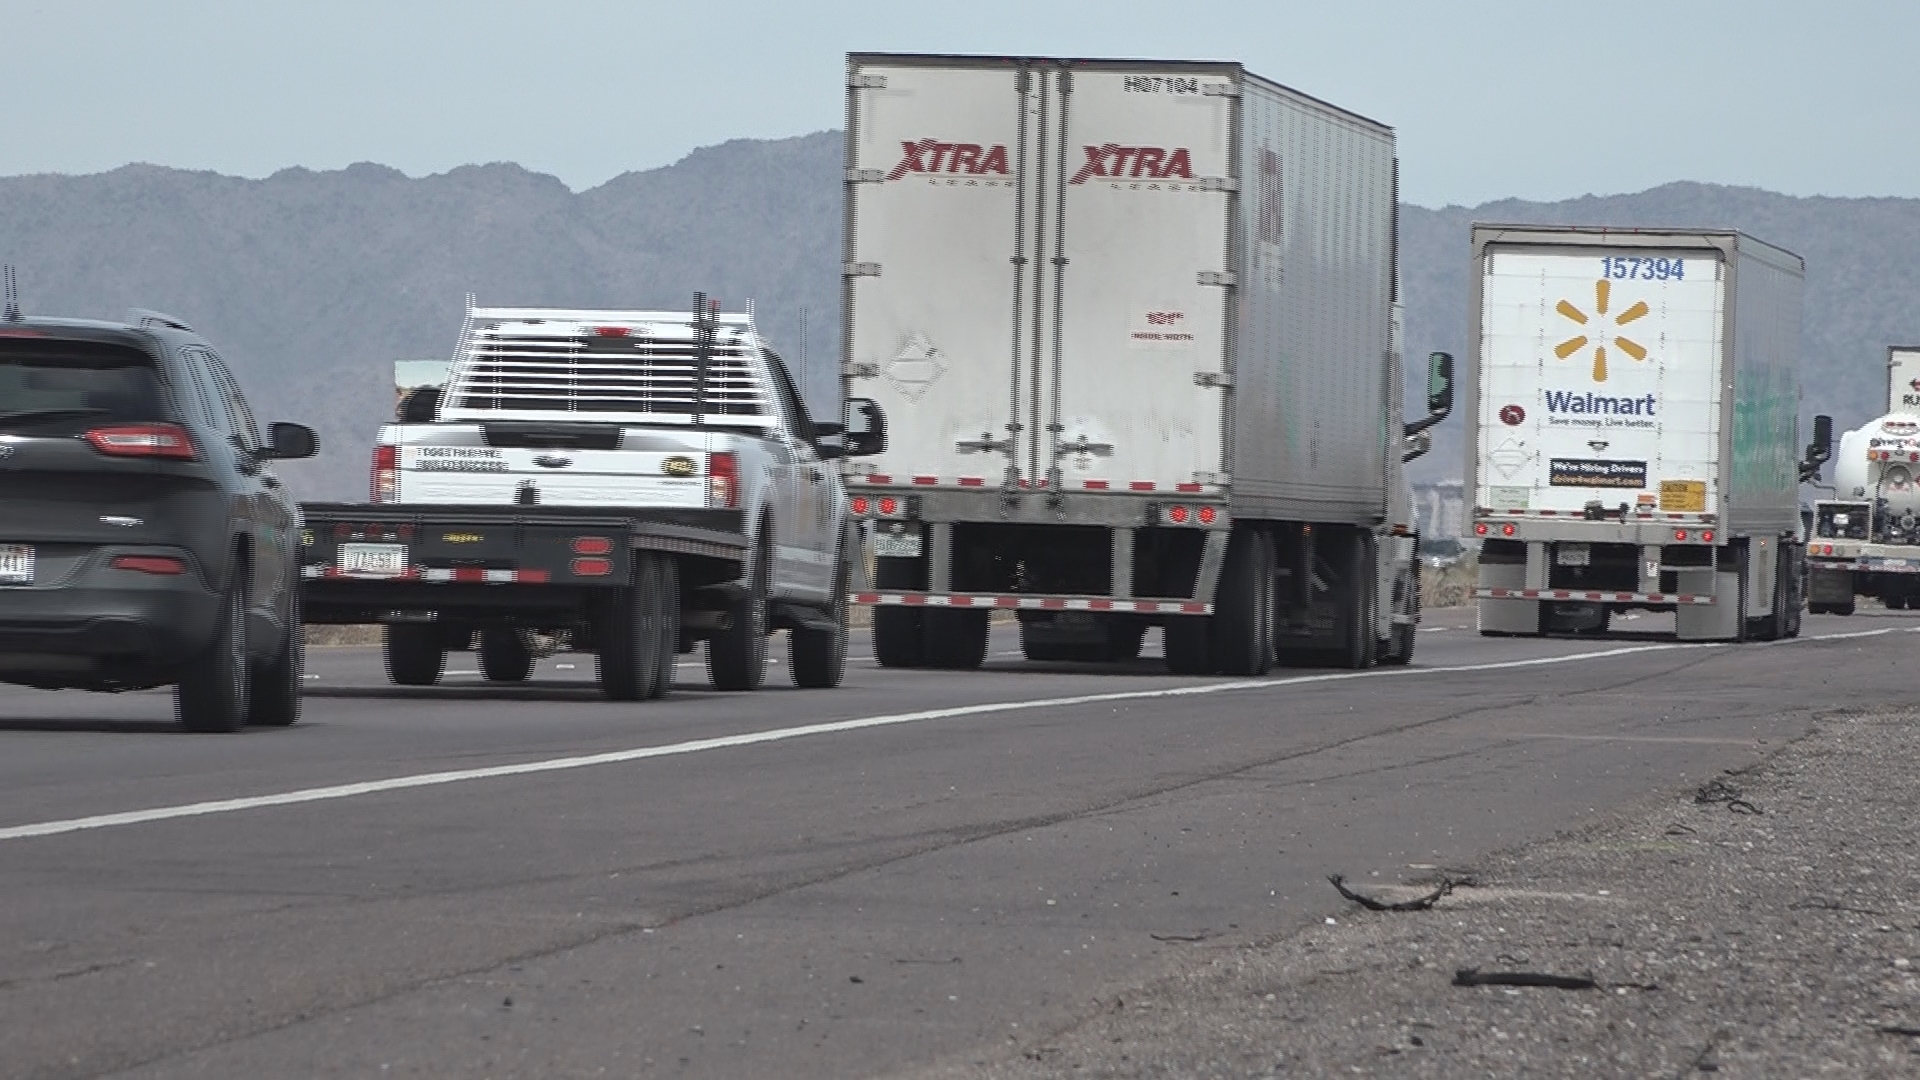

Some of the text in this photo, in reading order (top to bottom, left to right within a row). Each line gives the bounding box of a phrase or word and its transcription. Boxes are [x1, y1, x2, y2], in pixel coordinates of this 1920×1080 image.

[1124, 75, 1199, 94] H07104
[886, 138, 1009, 180] XTRA
[1068, 143, 1193, 184] XTRA
[1600, 256, 1685, 280] 157394
[1545, 390, 1656, 416] Walmart
[1548, 416, 1570, 425] Save
[1552, 461, 1644, 475] We're Hiring Drivers
